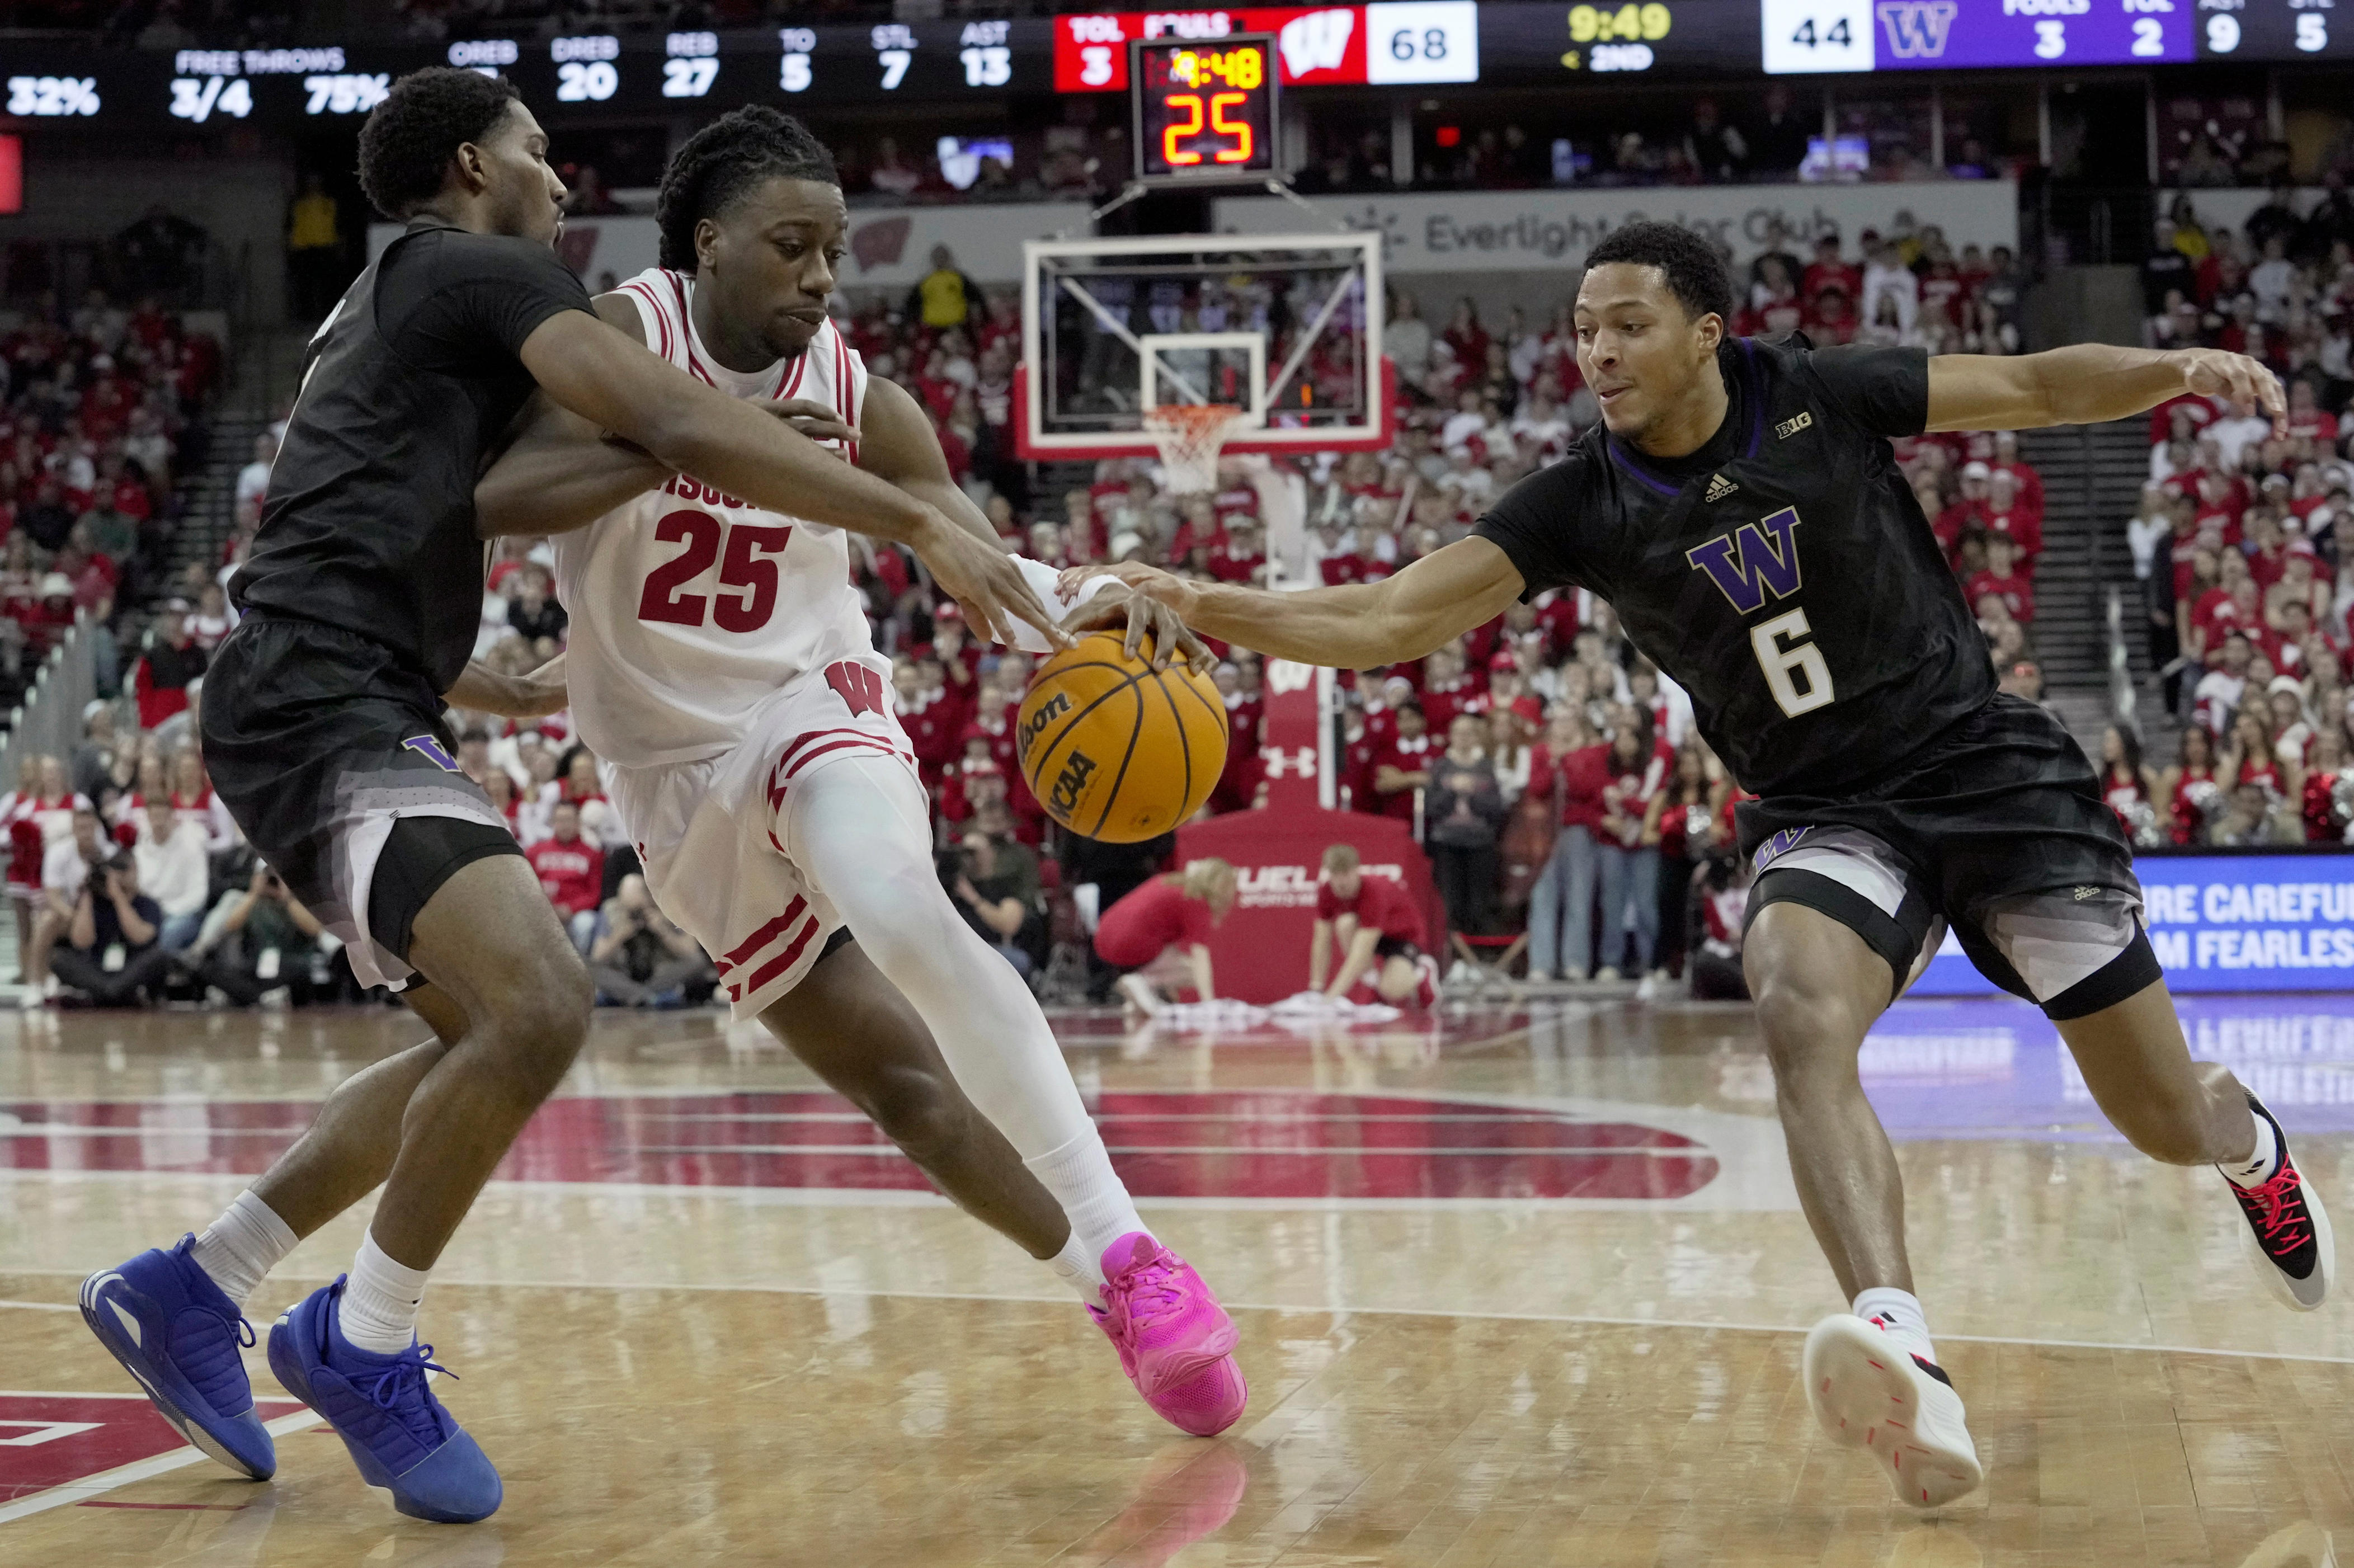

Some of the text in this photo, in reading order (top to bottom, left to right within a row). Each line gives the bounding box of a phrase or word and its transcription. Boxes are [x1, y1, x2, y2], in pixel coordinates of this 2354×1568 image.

[870, 24, 919, 50] STL
[959, 20, 1011, 46] AST
[1069, 16, 1125, 43] TOL
[1568, 3, 1672, 43] 9:49
[1792, 18, 1852, 48] 44
[2035, 20, 2065, 59] 3
[2131, 17, 2164, 56] 2
[2206, 13, 2240, 53] 9
[2295, 12, 2328, 51] 5
[175, 46, 346, 76] FREE THROWS
[666, 31, 719, 58] REB
[1391, 29, 1447, 61] 68
[1589, 44, 1654, 72] 2ND
[556, 60, 618, 101] 20
[662, 57, 719, 97] 27
[780, 53, 812, 92] 5
[879, 50, 911, 90] 7
[960, 46, 1011, 87] 13
[1081, 46, 1112, 86] 3
[1173, 48, 1262, 90] 9:48
[7, 76, 100, 116] 32%
[170, 73, 390, 123] 3/4 75%
[1162, 91, 1254, 166] 25
[1705, 483, 1739, 503] adidas
[638, 509, 793, 633] 25
[1685, 505, 1802, 616] W
[1750, 606, 1835, 719] 6
[1048, 750, 1097, 819] NCAA
[1752, 824, 1815, 876] W
[1234, 866, 1317, 892] UEL
